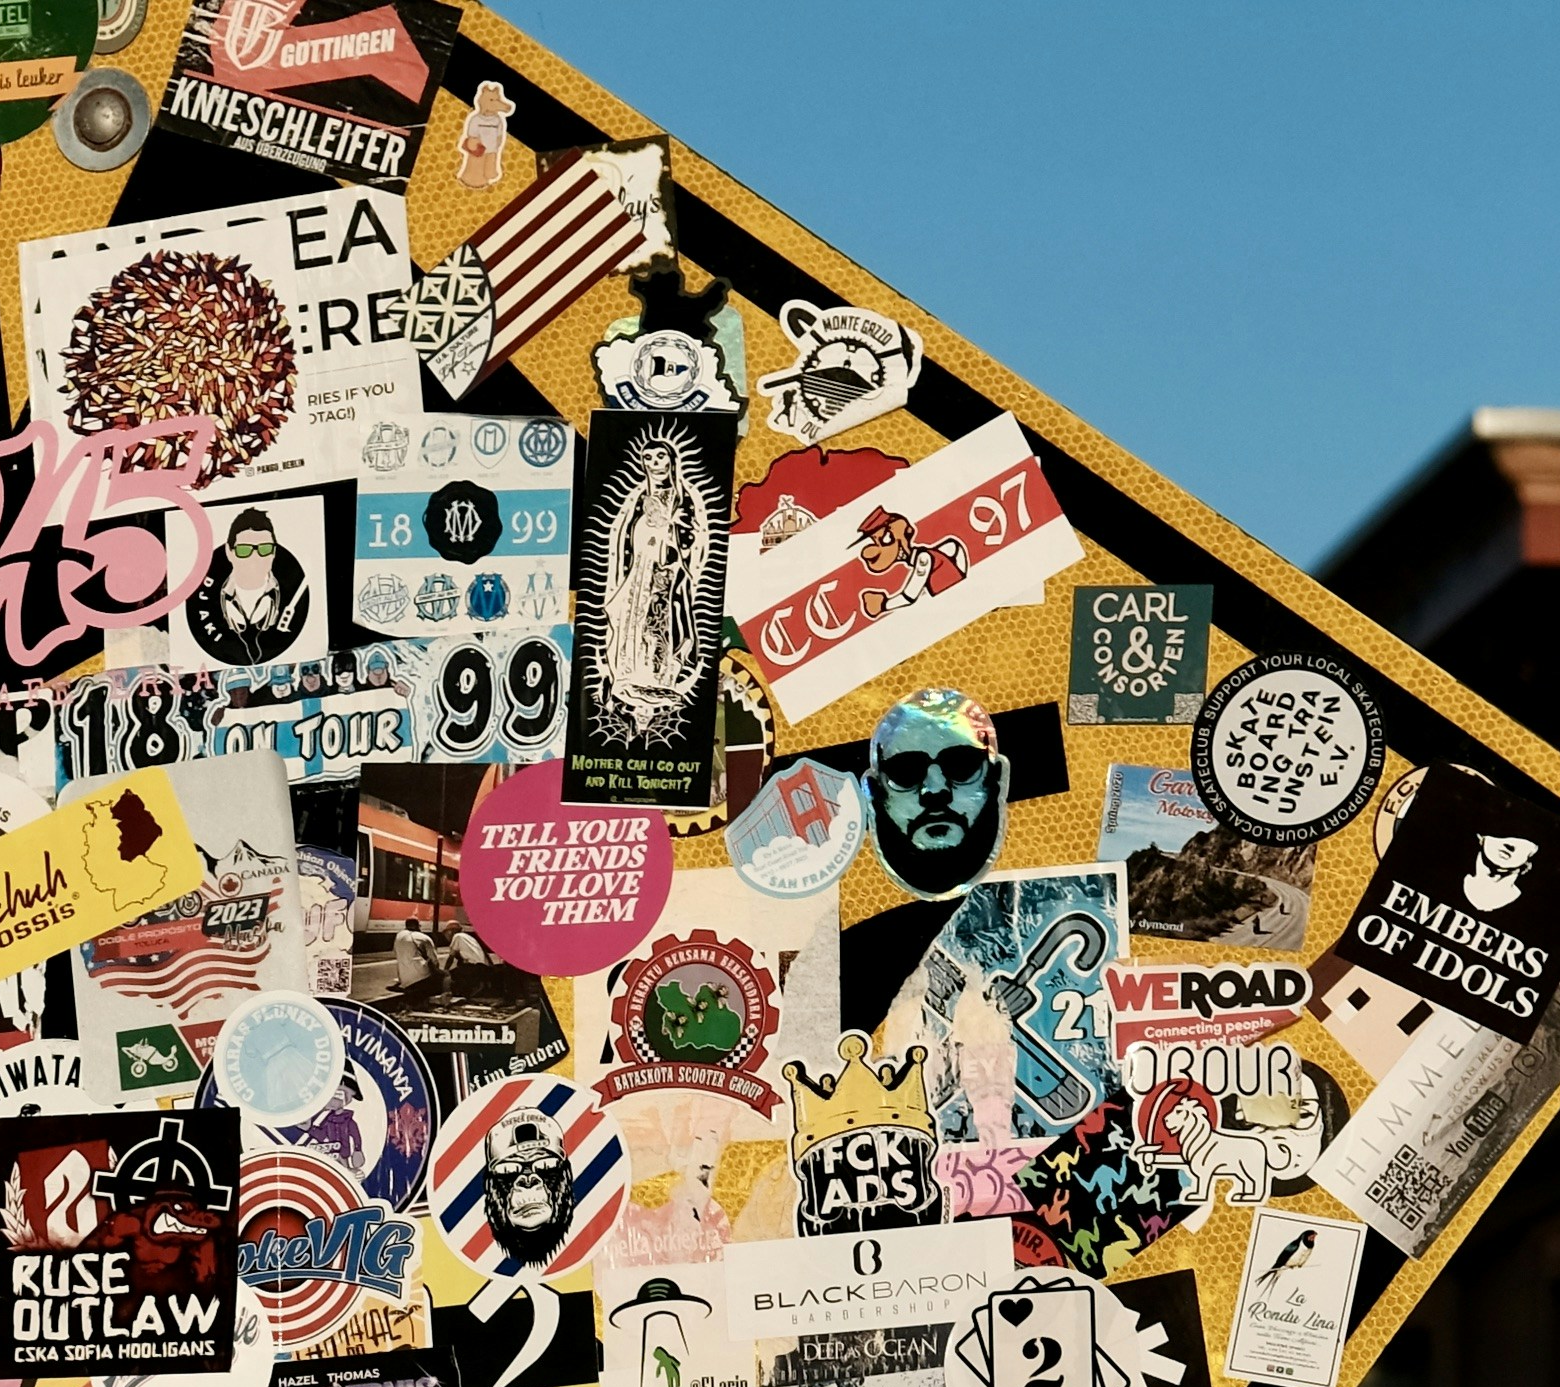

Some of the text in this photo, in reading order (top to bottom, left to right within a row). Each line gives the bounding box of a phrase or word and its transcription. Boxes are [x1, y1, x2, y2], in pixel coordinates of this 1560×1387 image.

[0, 67, 63, 89] is leuker
[170, 76, 406, 176] KNIESCHLEIFER
[822, 315, 861, 334] MONTE
[363, 382, 396, 399] YOU
[367, 510, 558, 548] 18 99
[967, 471, 1028, 547] 97
[1093, 592, 1188, 623] CARL
[1094, 628, 1185, 697] CONSORTEN
[1122, 626, 1156, 674] &
[434, 636, 563, 756] 99
[1204, 654, 1351, 720] SUPPORT YOUR LOCAL
[294, 708, 404, 759] TOUR
[1226, 689, 1277, 768] SKATE
[1236, 692, 1295, 789] BOARD
[1252, 690, 1321, 805] ING TRA
[571, 754, 701, 774] MOTHER GO OUT
[1278, 696, 1341, 814] UNSTEIN
[608, 774, 634, 790] KILL
[1106, 772, 1124, 834] Spring 2020
[480, 817, 650, 850] TELL YOUR
[241, 865, 290, 880] CANADA
[506, 844, 648, 875] FRIENDS
[768, 874, 800, 891] SAN
[802, 820, 858, 887] FRANCISCO
[490, 871, 644, 902] YOU LOVE
[207, 897, 266, 927] 2023
[540, 897, 639, 926] THEM
[1381, 880, 1549, 979] EMBERS
[98, 930, 136, 946] DOBLE
[630, 949, 760, 1022] BERSATU BERSAMA BERSAUDARA
[1357, 915, 1414, 957] OF
[1413, 938, 1540, 1019] IDOLS
[407, 1023, 516, 1044] vitamin.b
[1144, 1022, 1222, 1039] Connecting
[614, 1066, 765, 1103] BATASKOTA SCOOTER GROUP
[1445, 1091, 1504, 1159] YouTube
[822, 1131, 910, 1174] FCK
[820, 1170, 918, 1215] ADS
[12, 1252, 131, 1298] RUSE
[1286, 1287, 1305, 1306] La
[13, 1294, 221, 1341] OUTLAW
[14, 1340, 216, 1363] CSKA SOFIA HOOLIGANS
[803, 1338, 937, 1362] DEEP OCEAN
[279, 1368, 380, 1387] HAZEL THOMAS
